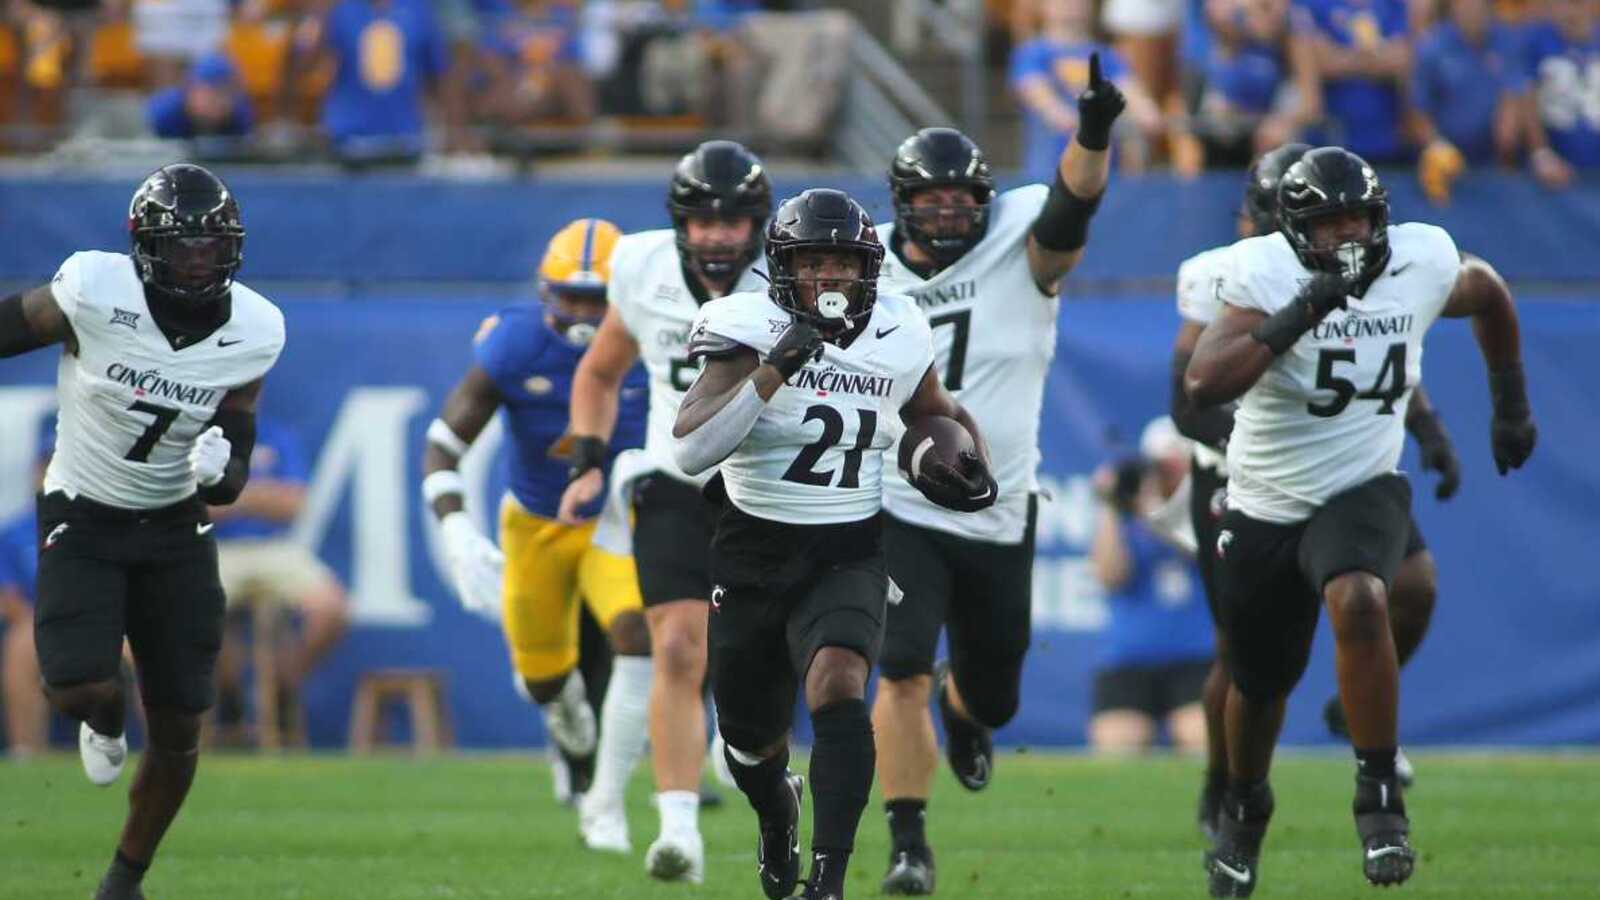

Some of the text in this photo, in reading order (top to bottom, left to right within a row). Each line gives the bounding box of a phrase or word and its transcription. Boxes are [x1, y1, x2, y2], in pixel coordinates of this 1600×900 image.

[1313, 314, 1413, 340] CINCINNATI
[106, 362, 216, 407] CINCINNATI
[1307, 342, 1406, 418] 54
[124, 399, 183, 463] 7
[780, 404, 878, 489] 21
